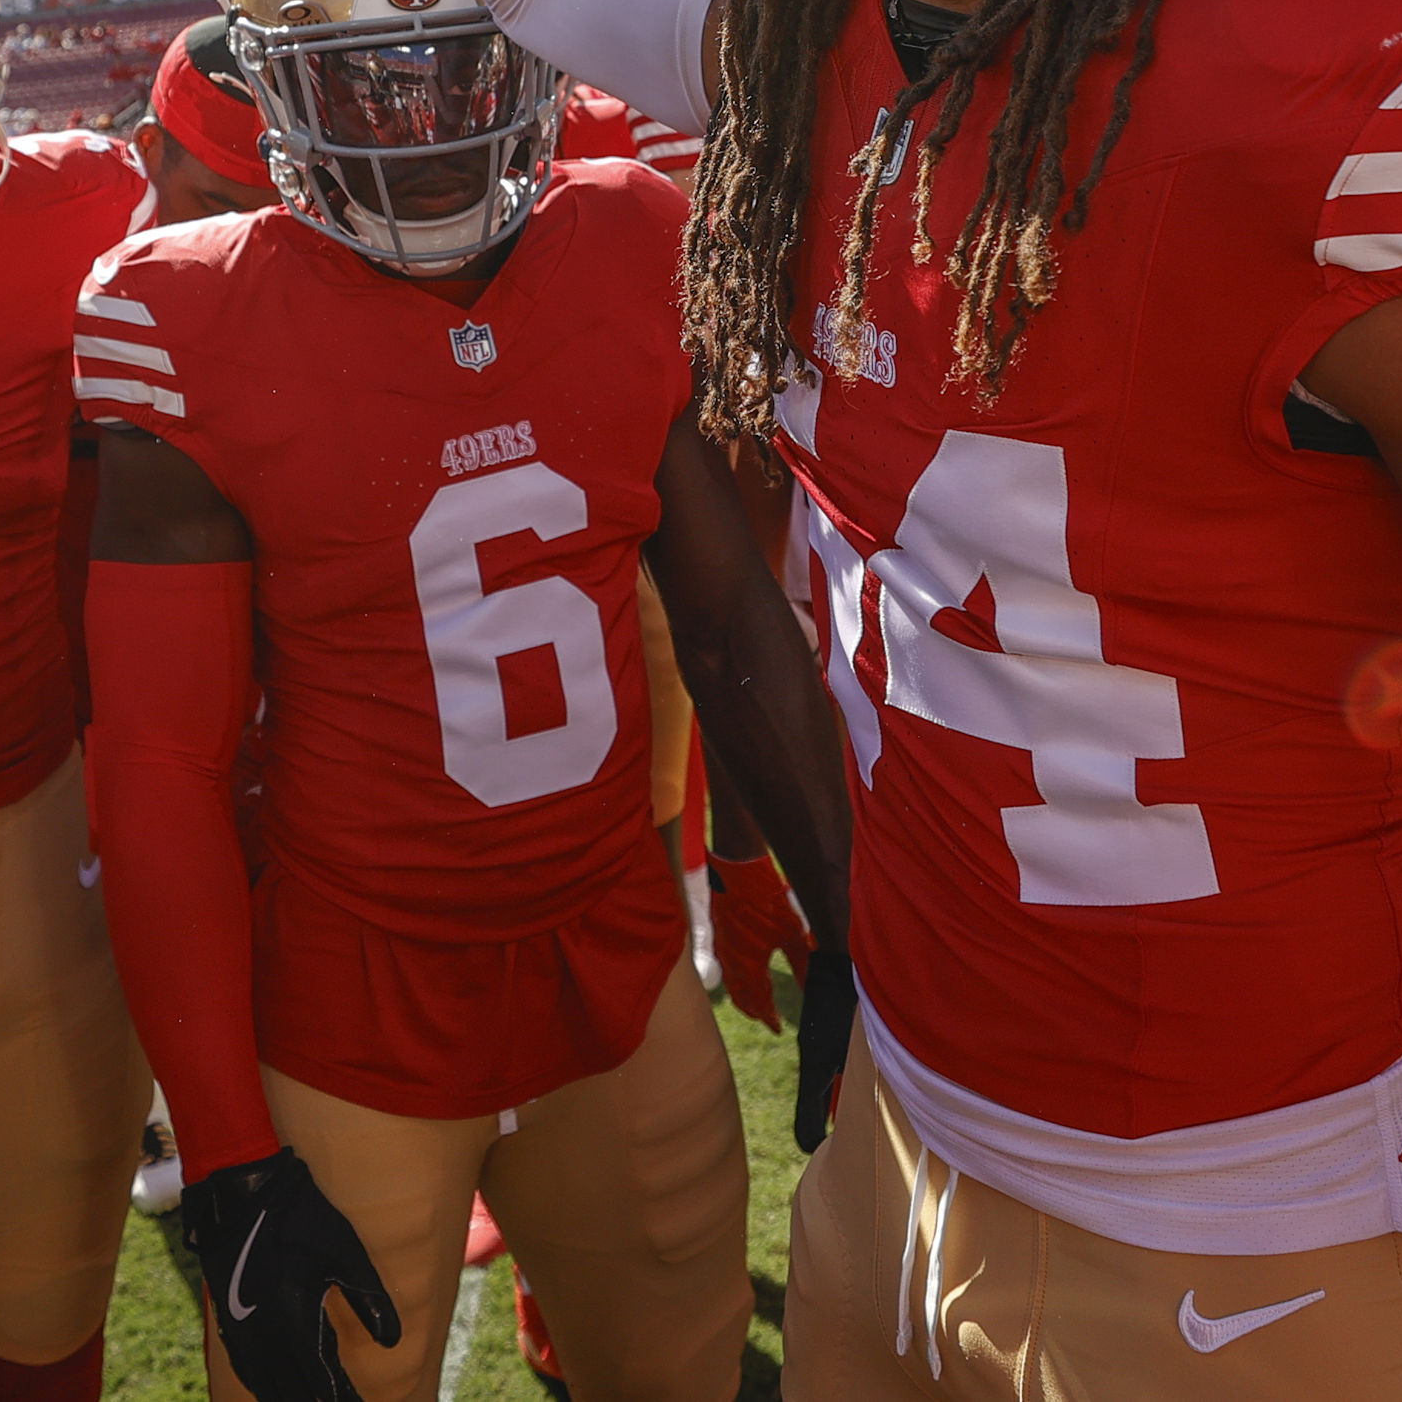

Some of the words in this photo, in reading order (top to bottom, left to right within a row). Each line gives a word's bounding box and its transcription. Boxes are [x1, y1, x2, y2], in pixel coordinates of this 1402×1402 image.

[458, 341, 490, 362] NFL
[440, 419, 537, 477] 49ERS
[409, 461, 618, 809] 6
